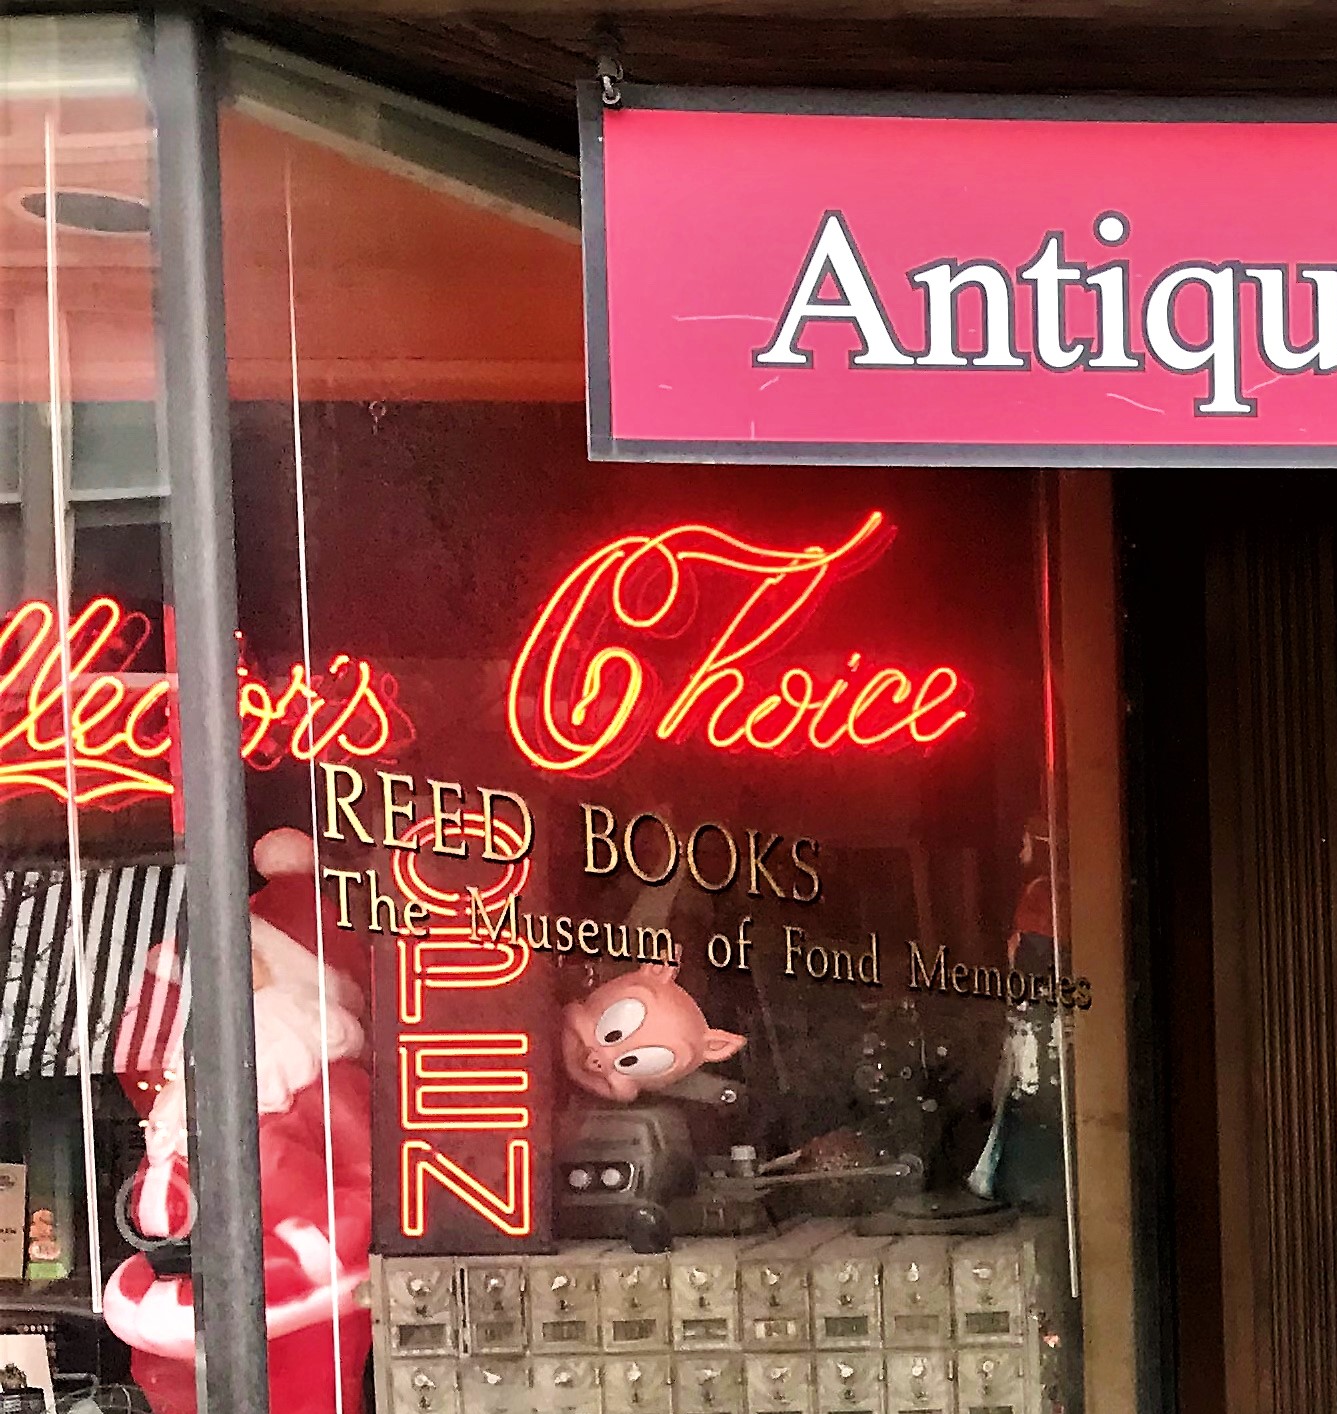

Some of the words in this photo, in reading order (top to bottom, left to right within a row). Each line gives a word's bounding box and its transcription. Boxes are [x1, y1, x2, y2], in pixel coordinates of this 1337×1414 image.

[506, 510, 970, 772] Choice
[321, 761, 535, 866] REED
[579, 802, 825, 906] BOOKS
[323, 866, 428, 937] The
[470, 886, 682, 967] Museum
[707, 917, 754, 972] of
[782, 922, 884, 988] Fond
[909, 938, 1095, 1010] Memories
[391, 812, 534, 1240] OPEN
